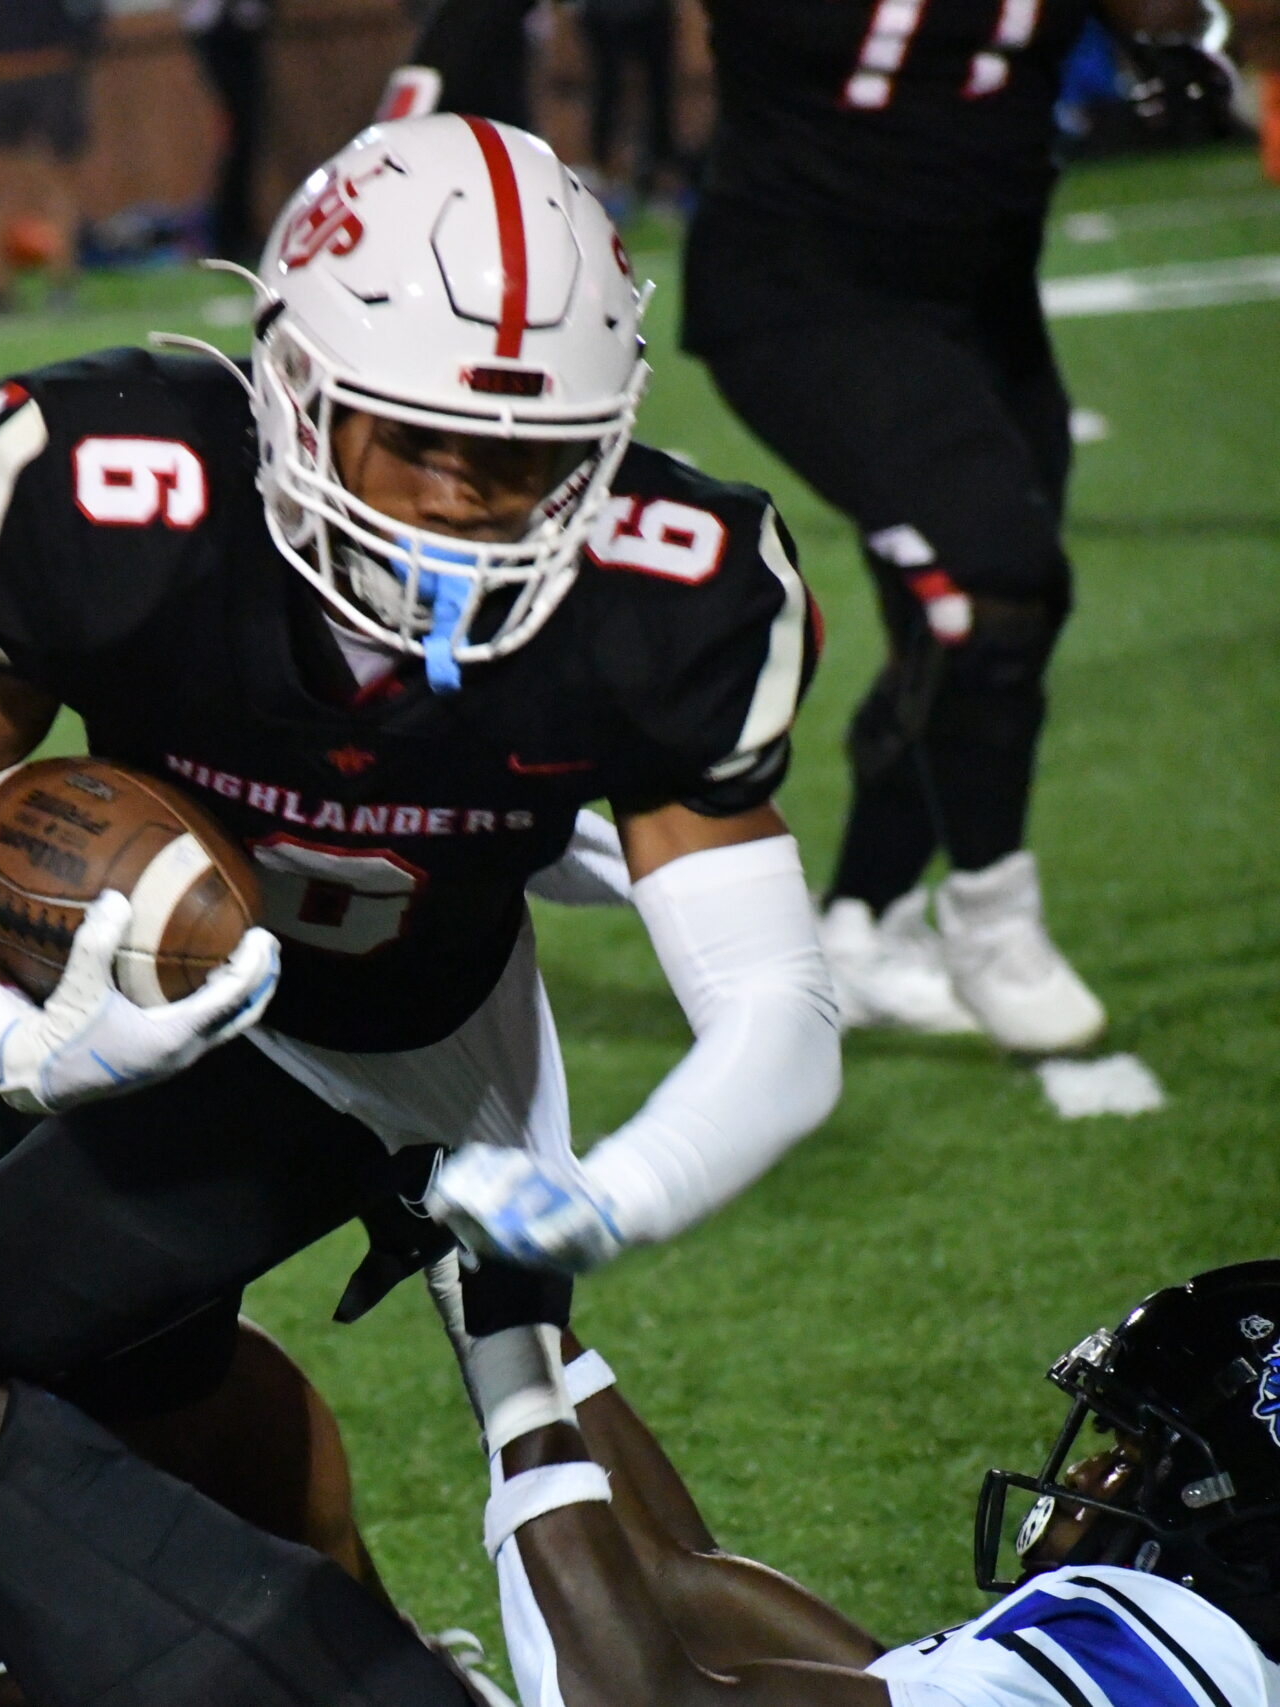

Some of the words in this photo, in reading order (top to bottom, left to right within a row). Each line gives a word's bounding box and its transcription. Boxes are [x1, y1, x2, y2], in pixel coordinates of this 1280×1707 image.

[72, 434, 209, 531] 6
[583, 493, 728, 587] 6
[164, 753, 534, 836] HIGHLANDERS
[248, 831, 429, 957] 6
